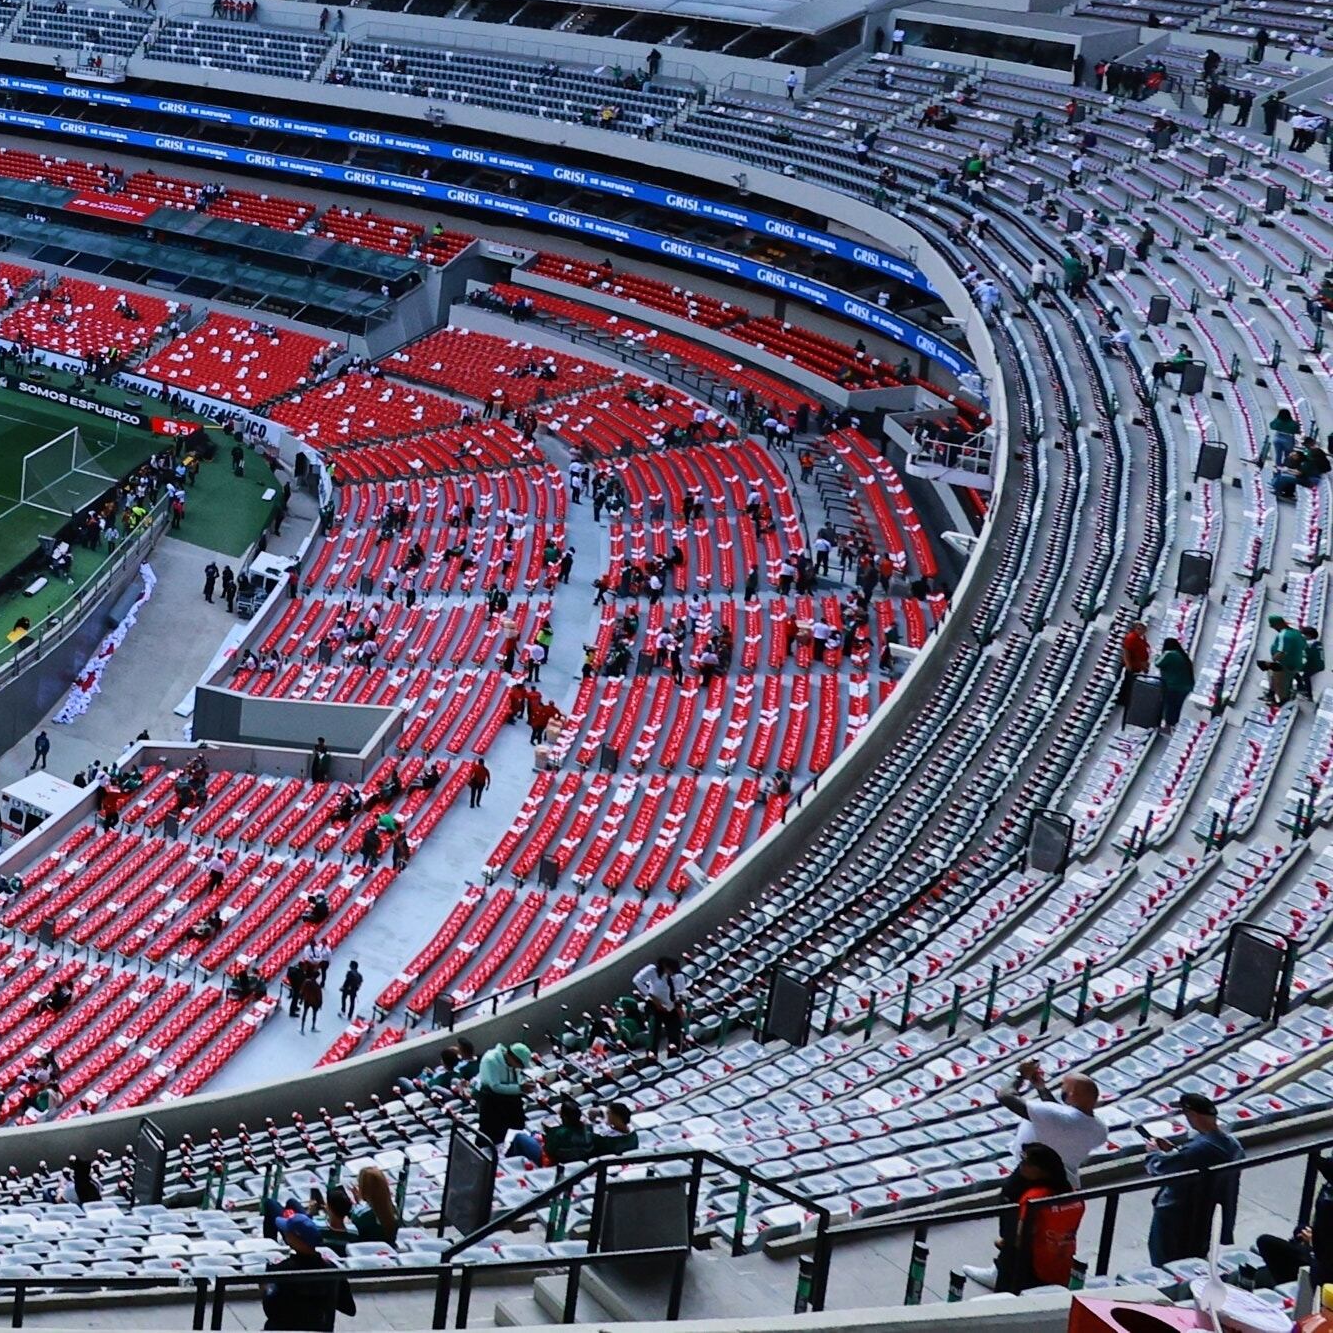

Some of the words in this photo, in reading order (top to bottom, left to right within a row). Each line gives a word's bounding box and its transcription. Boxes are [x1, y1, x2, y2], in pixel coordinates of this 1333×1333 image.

[63, 87, 90, 99] GRISI
[159, 101, 187, 114] GRISI
[60, 122, 87, 134] GRISI
[249, 115, 279, 129] GRISI
[155, 138, 184, 151] GRISI
[348, 130, 380, 145] GRISI
[245, 153, 276, 167] GRISI
[452, 148, 486, 163] GRISI
[344, 170, 376, 185] GRISI
[553, 167, 585, 184] GRISI
[447, 189, 479, 205] GRISI
[666, 194, 698, 211] GRISI
[548, 211, 580, 228] GRISI
[765, 220, 794, 238] GRISI
[660, 240, 692, 258] GRISI
[853, 248, 879, 267] GRISI
[757, 268, 786, 288] GRISI
[844, 300, 870, 321] GRISI
[19, 382, 68, 404] SOMOS
[69, 395, 141, 426] ESFUERZO
